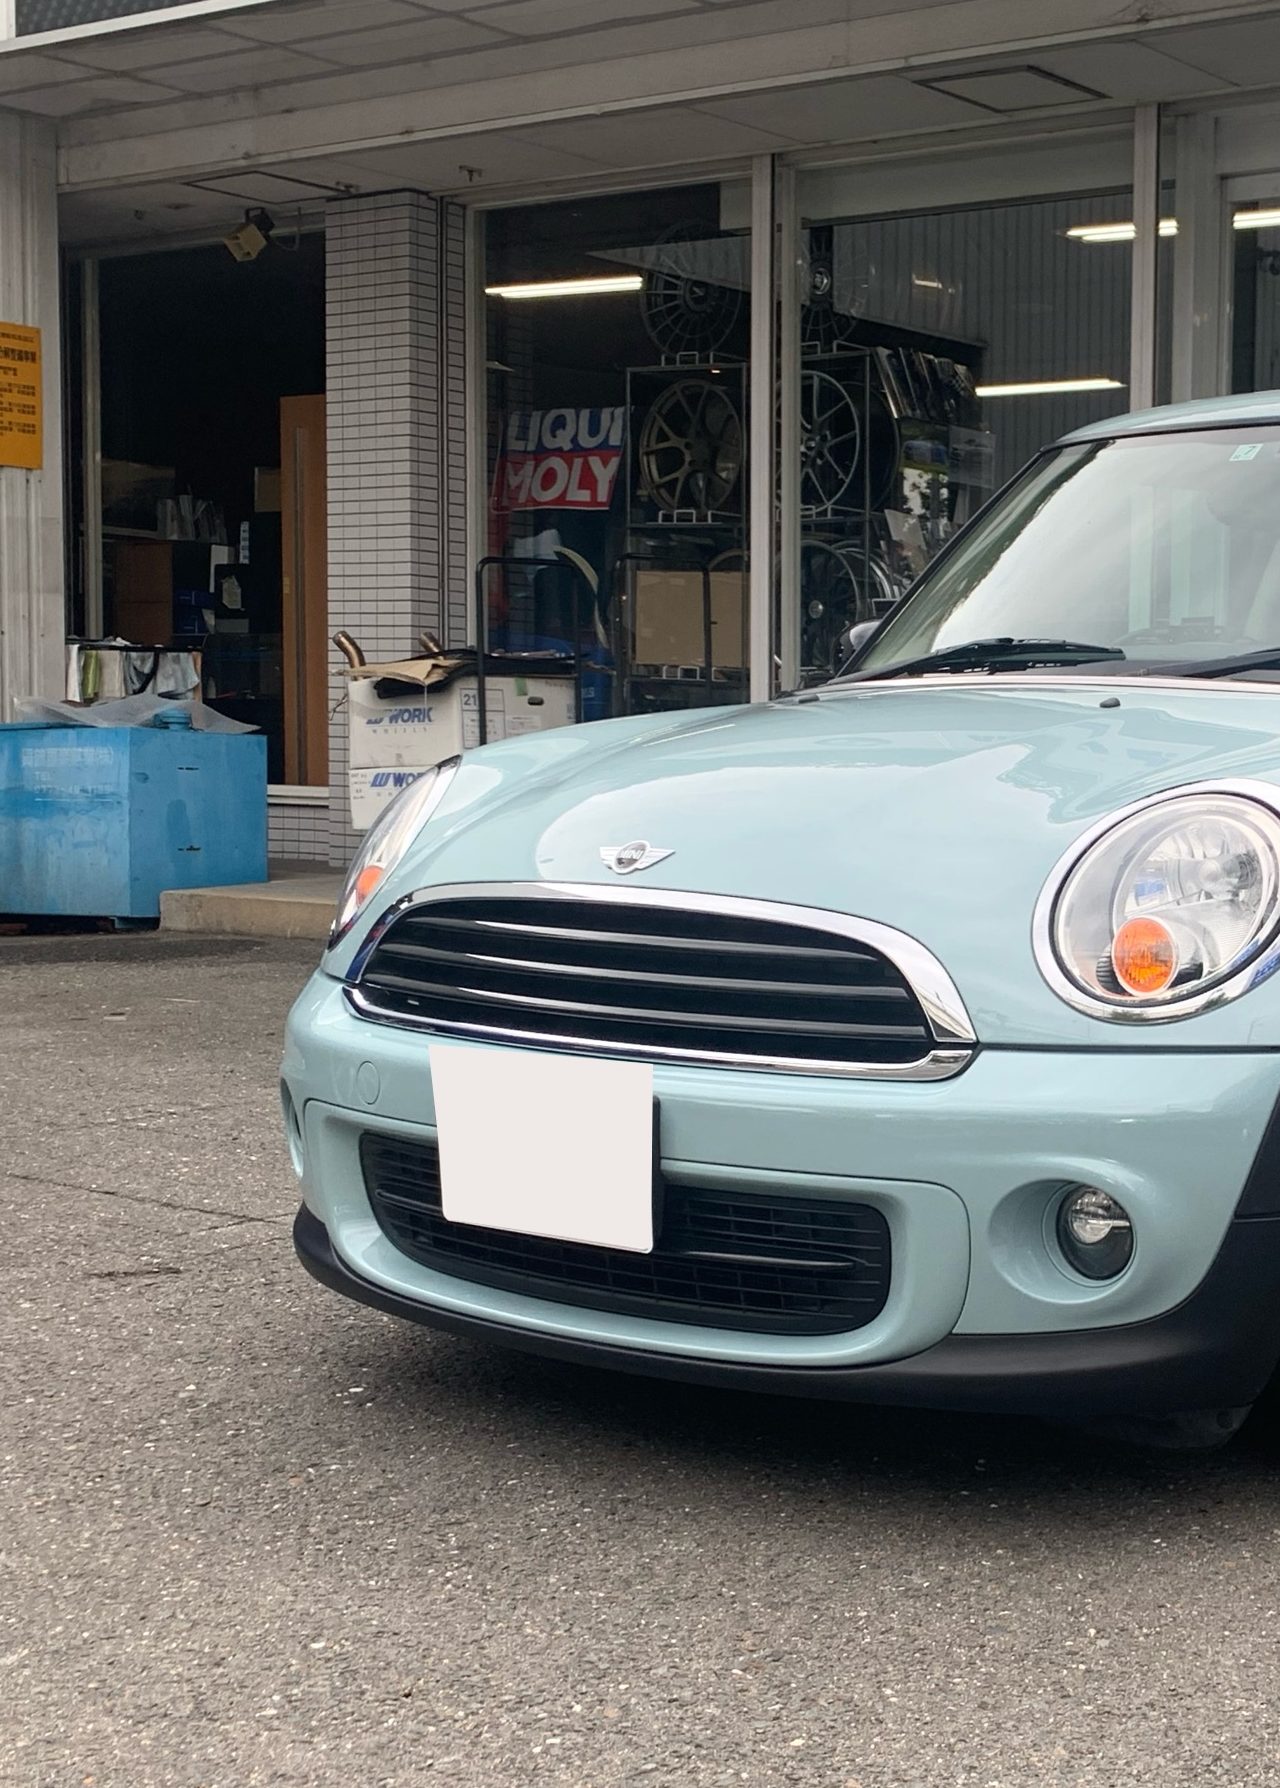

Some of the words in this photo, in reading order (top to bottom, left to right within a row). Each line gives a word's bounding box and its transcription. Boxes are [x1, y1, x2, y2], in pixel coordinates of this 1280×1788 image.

[506, 406, 626, 451] LIQUI
[503, 456, 621, 503] MOLY
[388, 706, 434, 725] WORK
[622, 847, 645, 860] MINI
